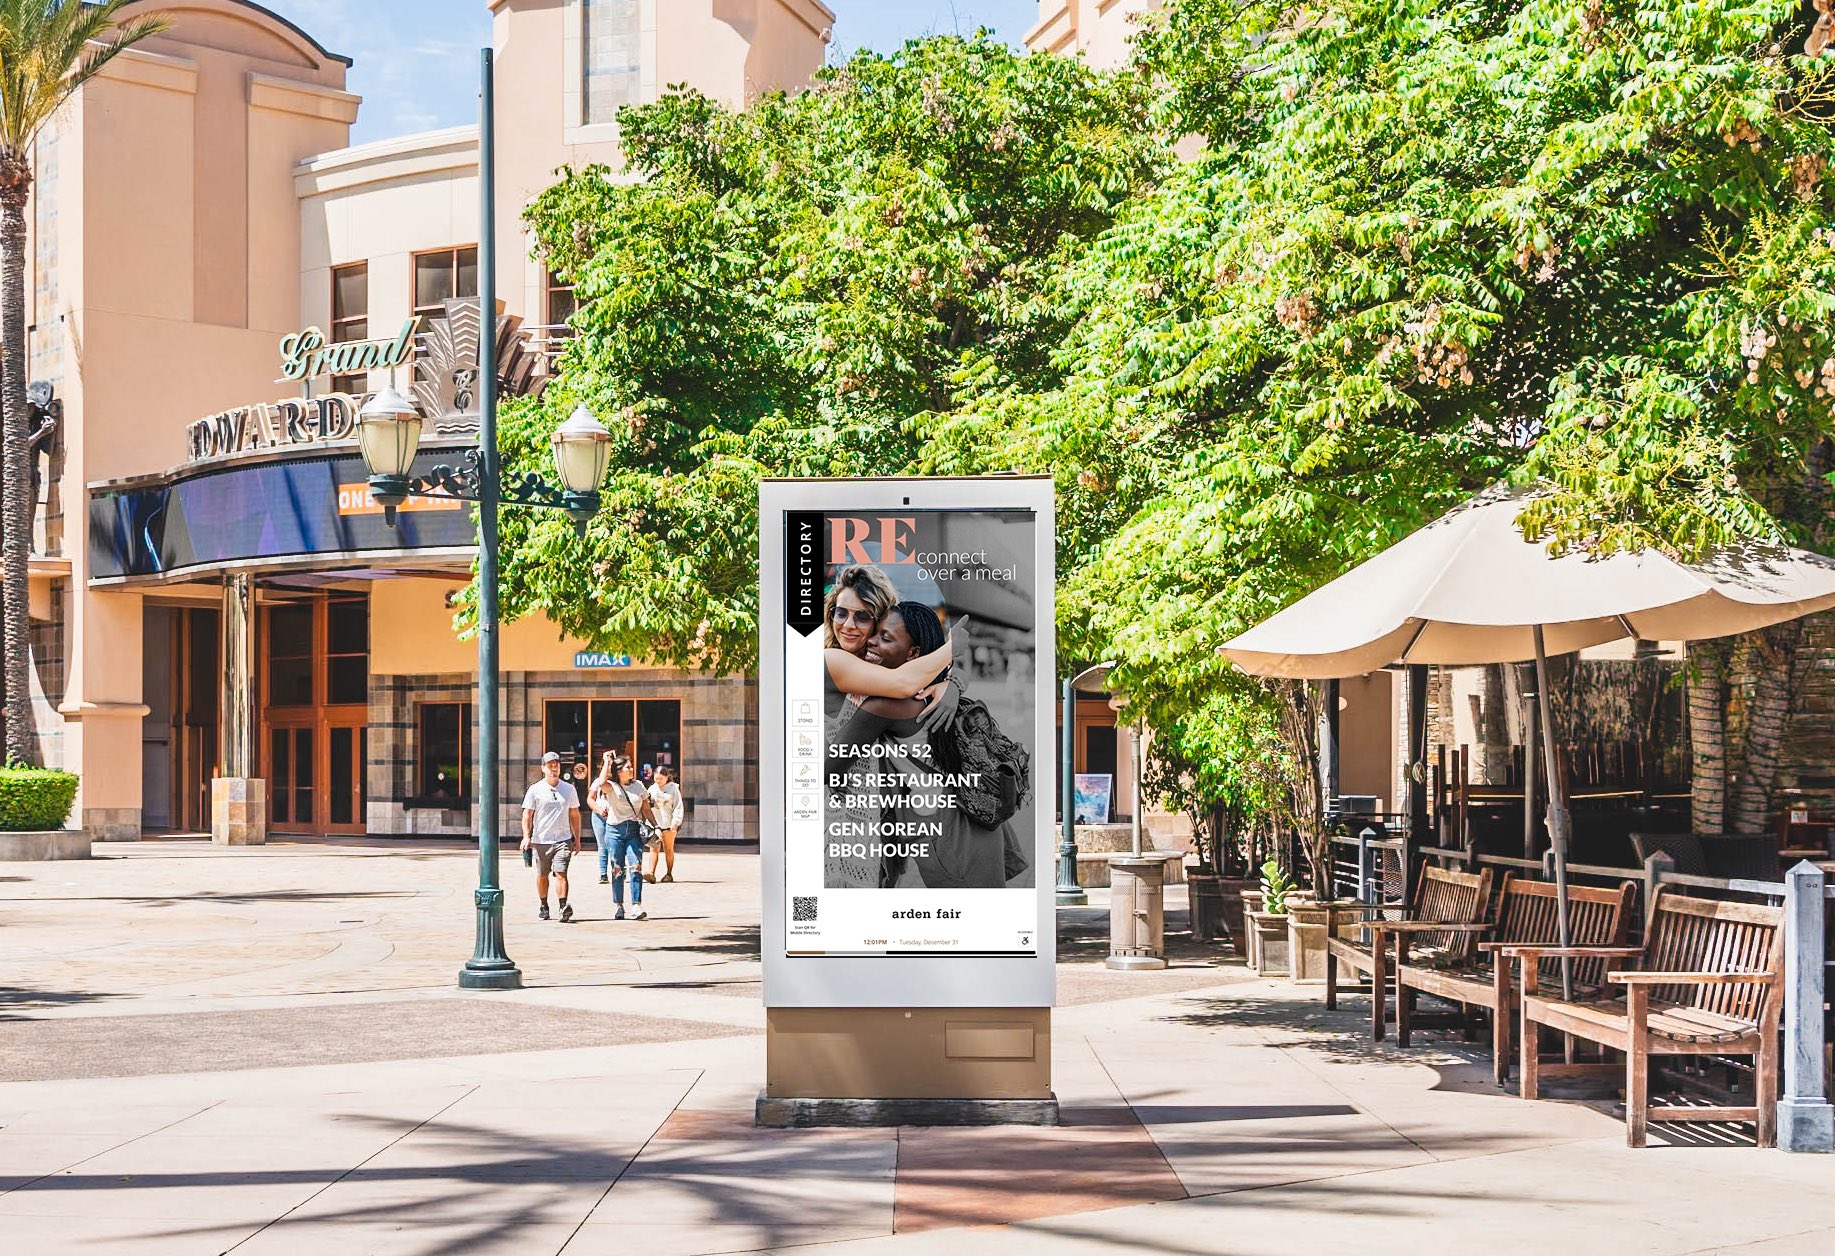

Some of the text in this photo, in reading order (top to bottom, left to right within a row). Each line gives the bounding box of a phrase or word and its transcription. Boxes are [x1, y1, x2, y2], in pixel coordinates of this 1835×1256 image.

[280, 316, 421, 380] Grand
[186, 391, 377, 460] EDWARD
[826, 518, 987, 565] RE connect
[800, 521, 812, 616] DIRECTORY
[917, 564, 1016, 581] over a meal
[576, 654, 625, 666] IMAX
[829, 744, 932, 758] SEASONS 52
[865, 773, 982, 787] RESTAURANT
[829, 794, 957, 809] & BREWHOUSE
[829, 822, 943, 836] GEN KOREAN
[829, 843, 930, 860] BBQ HOUSE
[892, 908, 962, 919] arden fair
[863, 938, 959, 947] 12:01PM Tuesday, December 31
